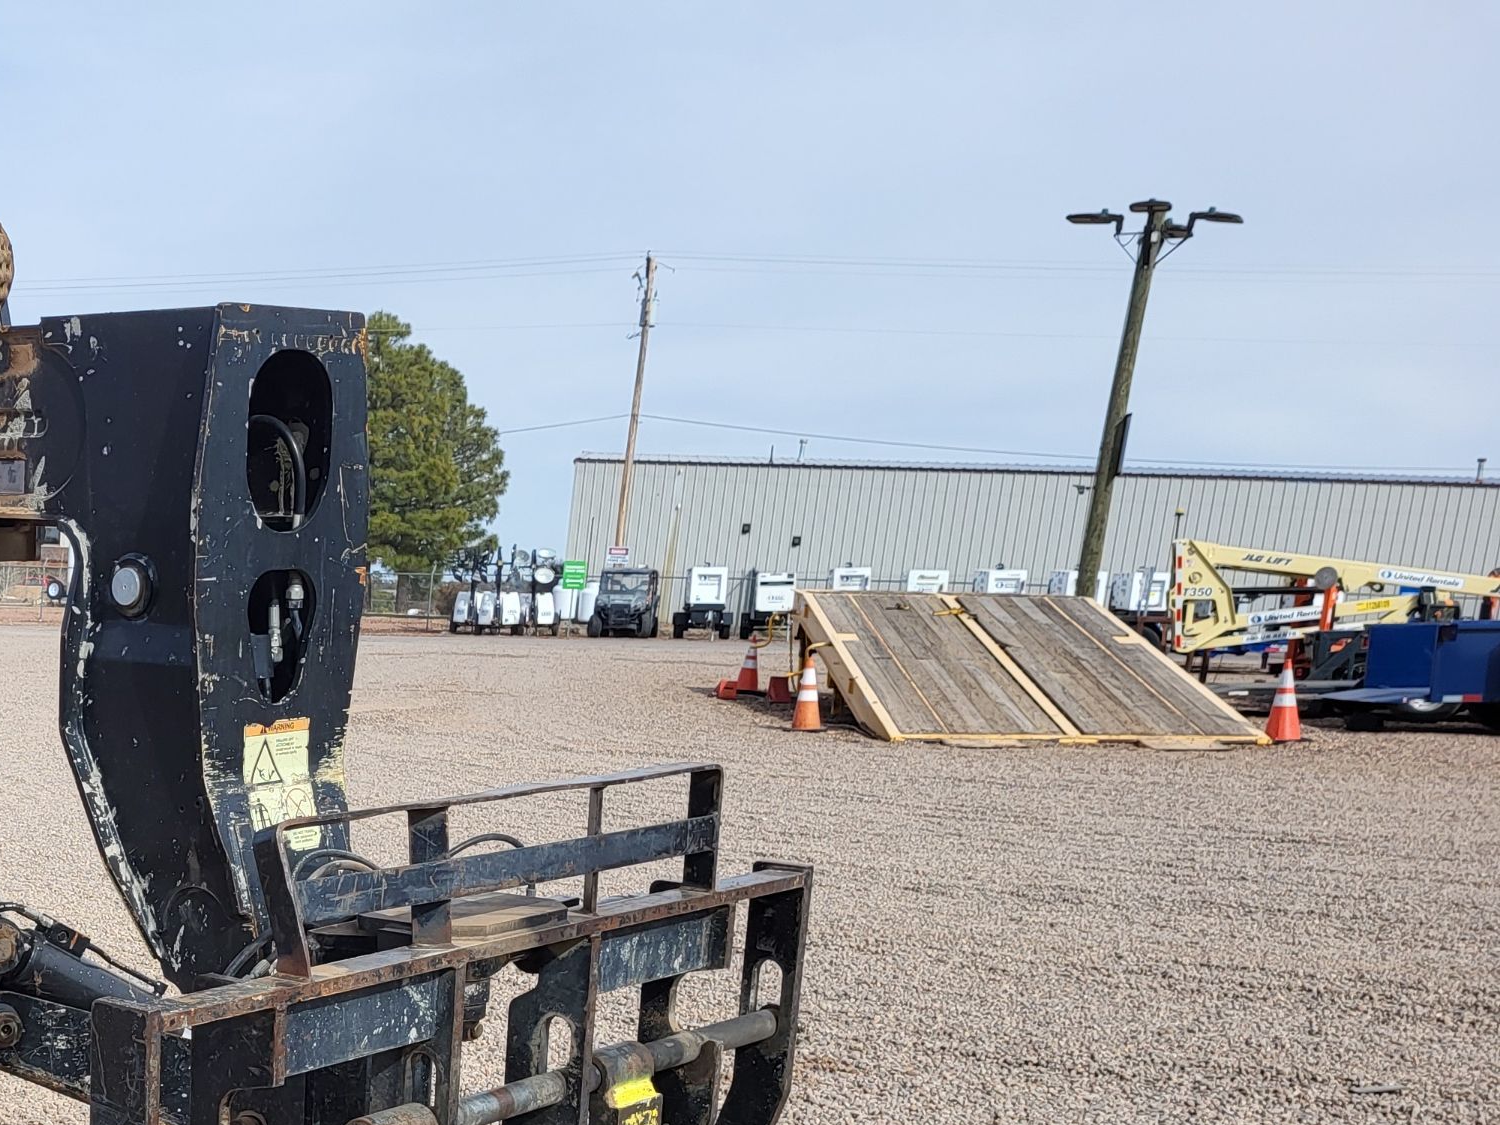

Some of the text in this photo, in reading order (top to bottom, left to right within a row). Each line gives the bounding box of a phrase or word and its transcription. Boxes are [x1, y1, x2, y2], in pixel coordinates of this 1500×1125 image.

[1242, 553, 1293, 566] JLG LIFT
[1394, 572, 1460, 587] United Rentals
[1184, 587, 1213, 597] T350
[1264, 610, 1295, 623] United
